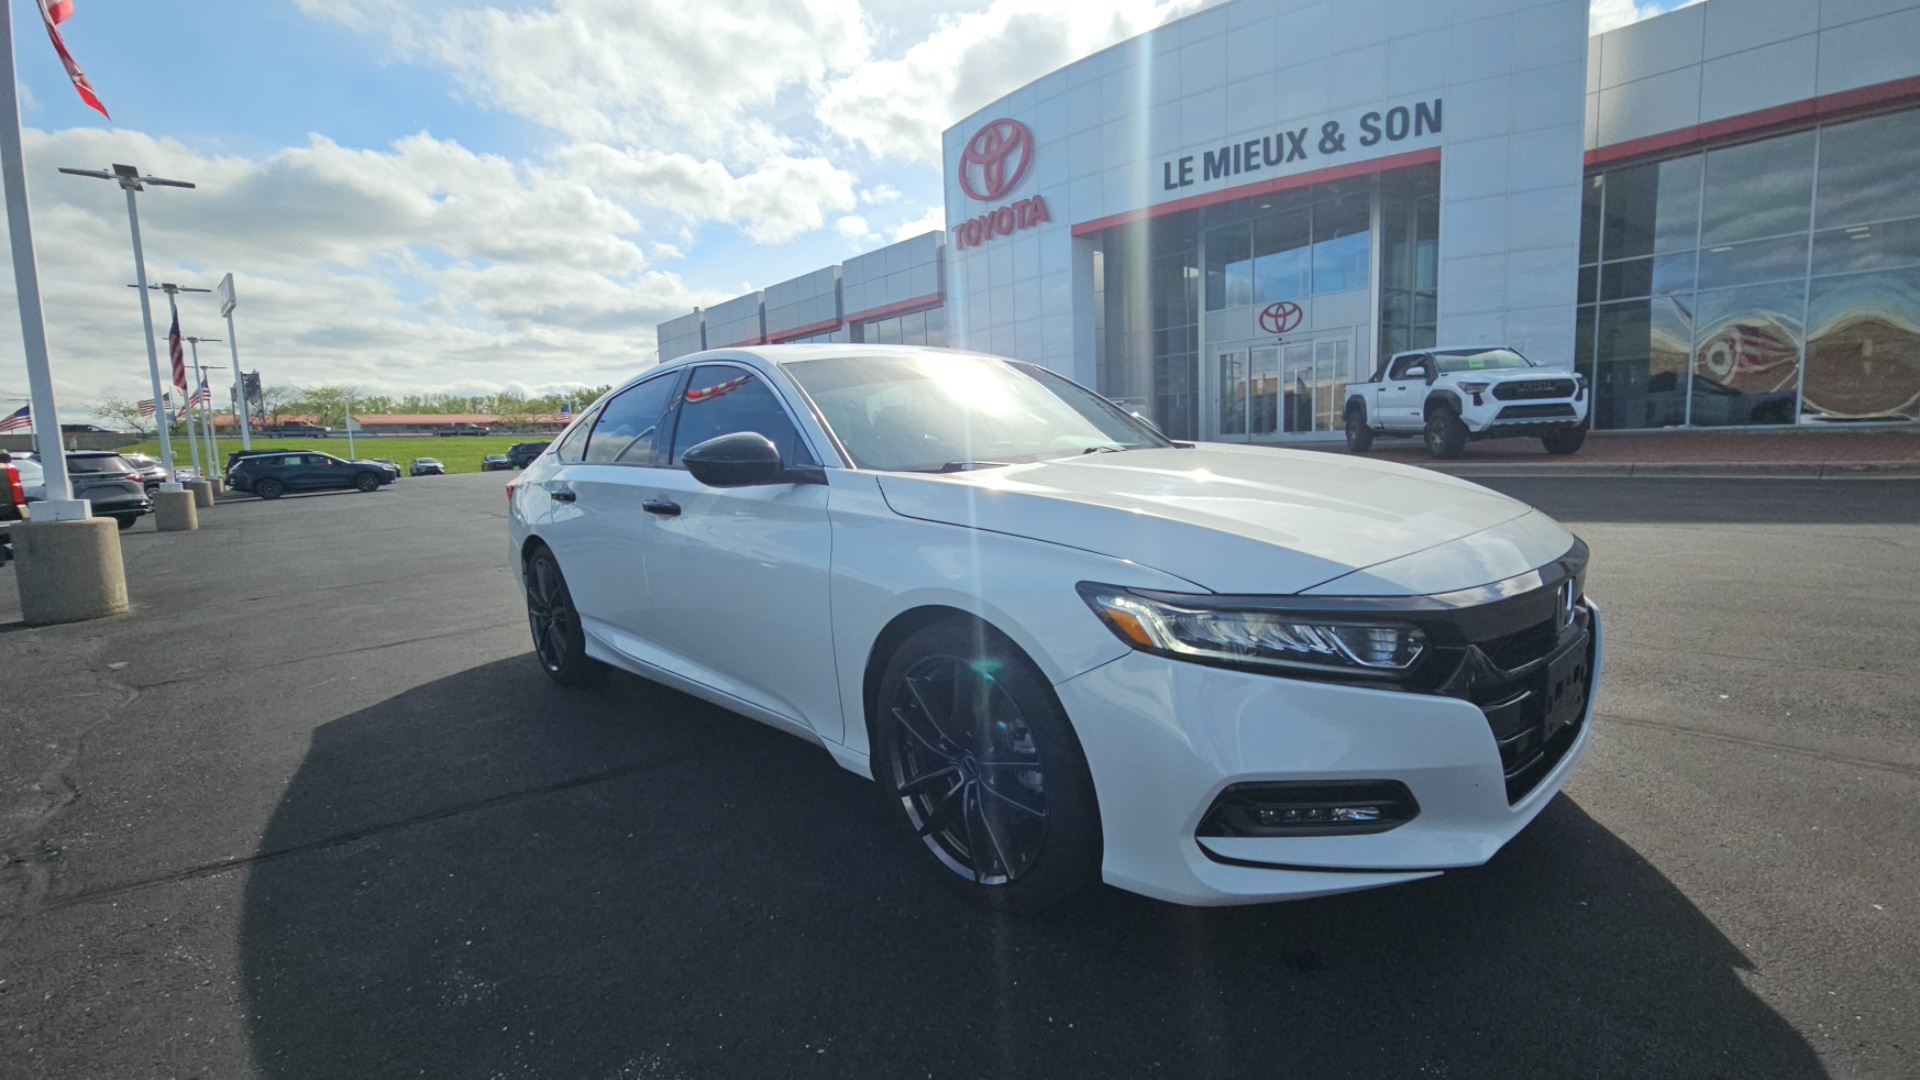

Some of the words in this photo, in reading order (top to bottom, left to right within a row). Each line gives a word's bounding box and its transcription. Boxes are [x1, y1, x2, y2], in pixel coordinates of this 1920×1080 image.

[1164, 155, 1194, 190] LE
[1203, 127, 1309, 182] MIEUX
[1318, 120, 1346, 155] &
[1359, 98, 1443, 147] SON
[951, 194, 1051, 251] TOYOTA
